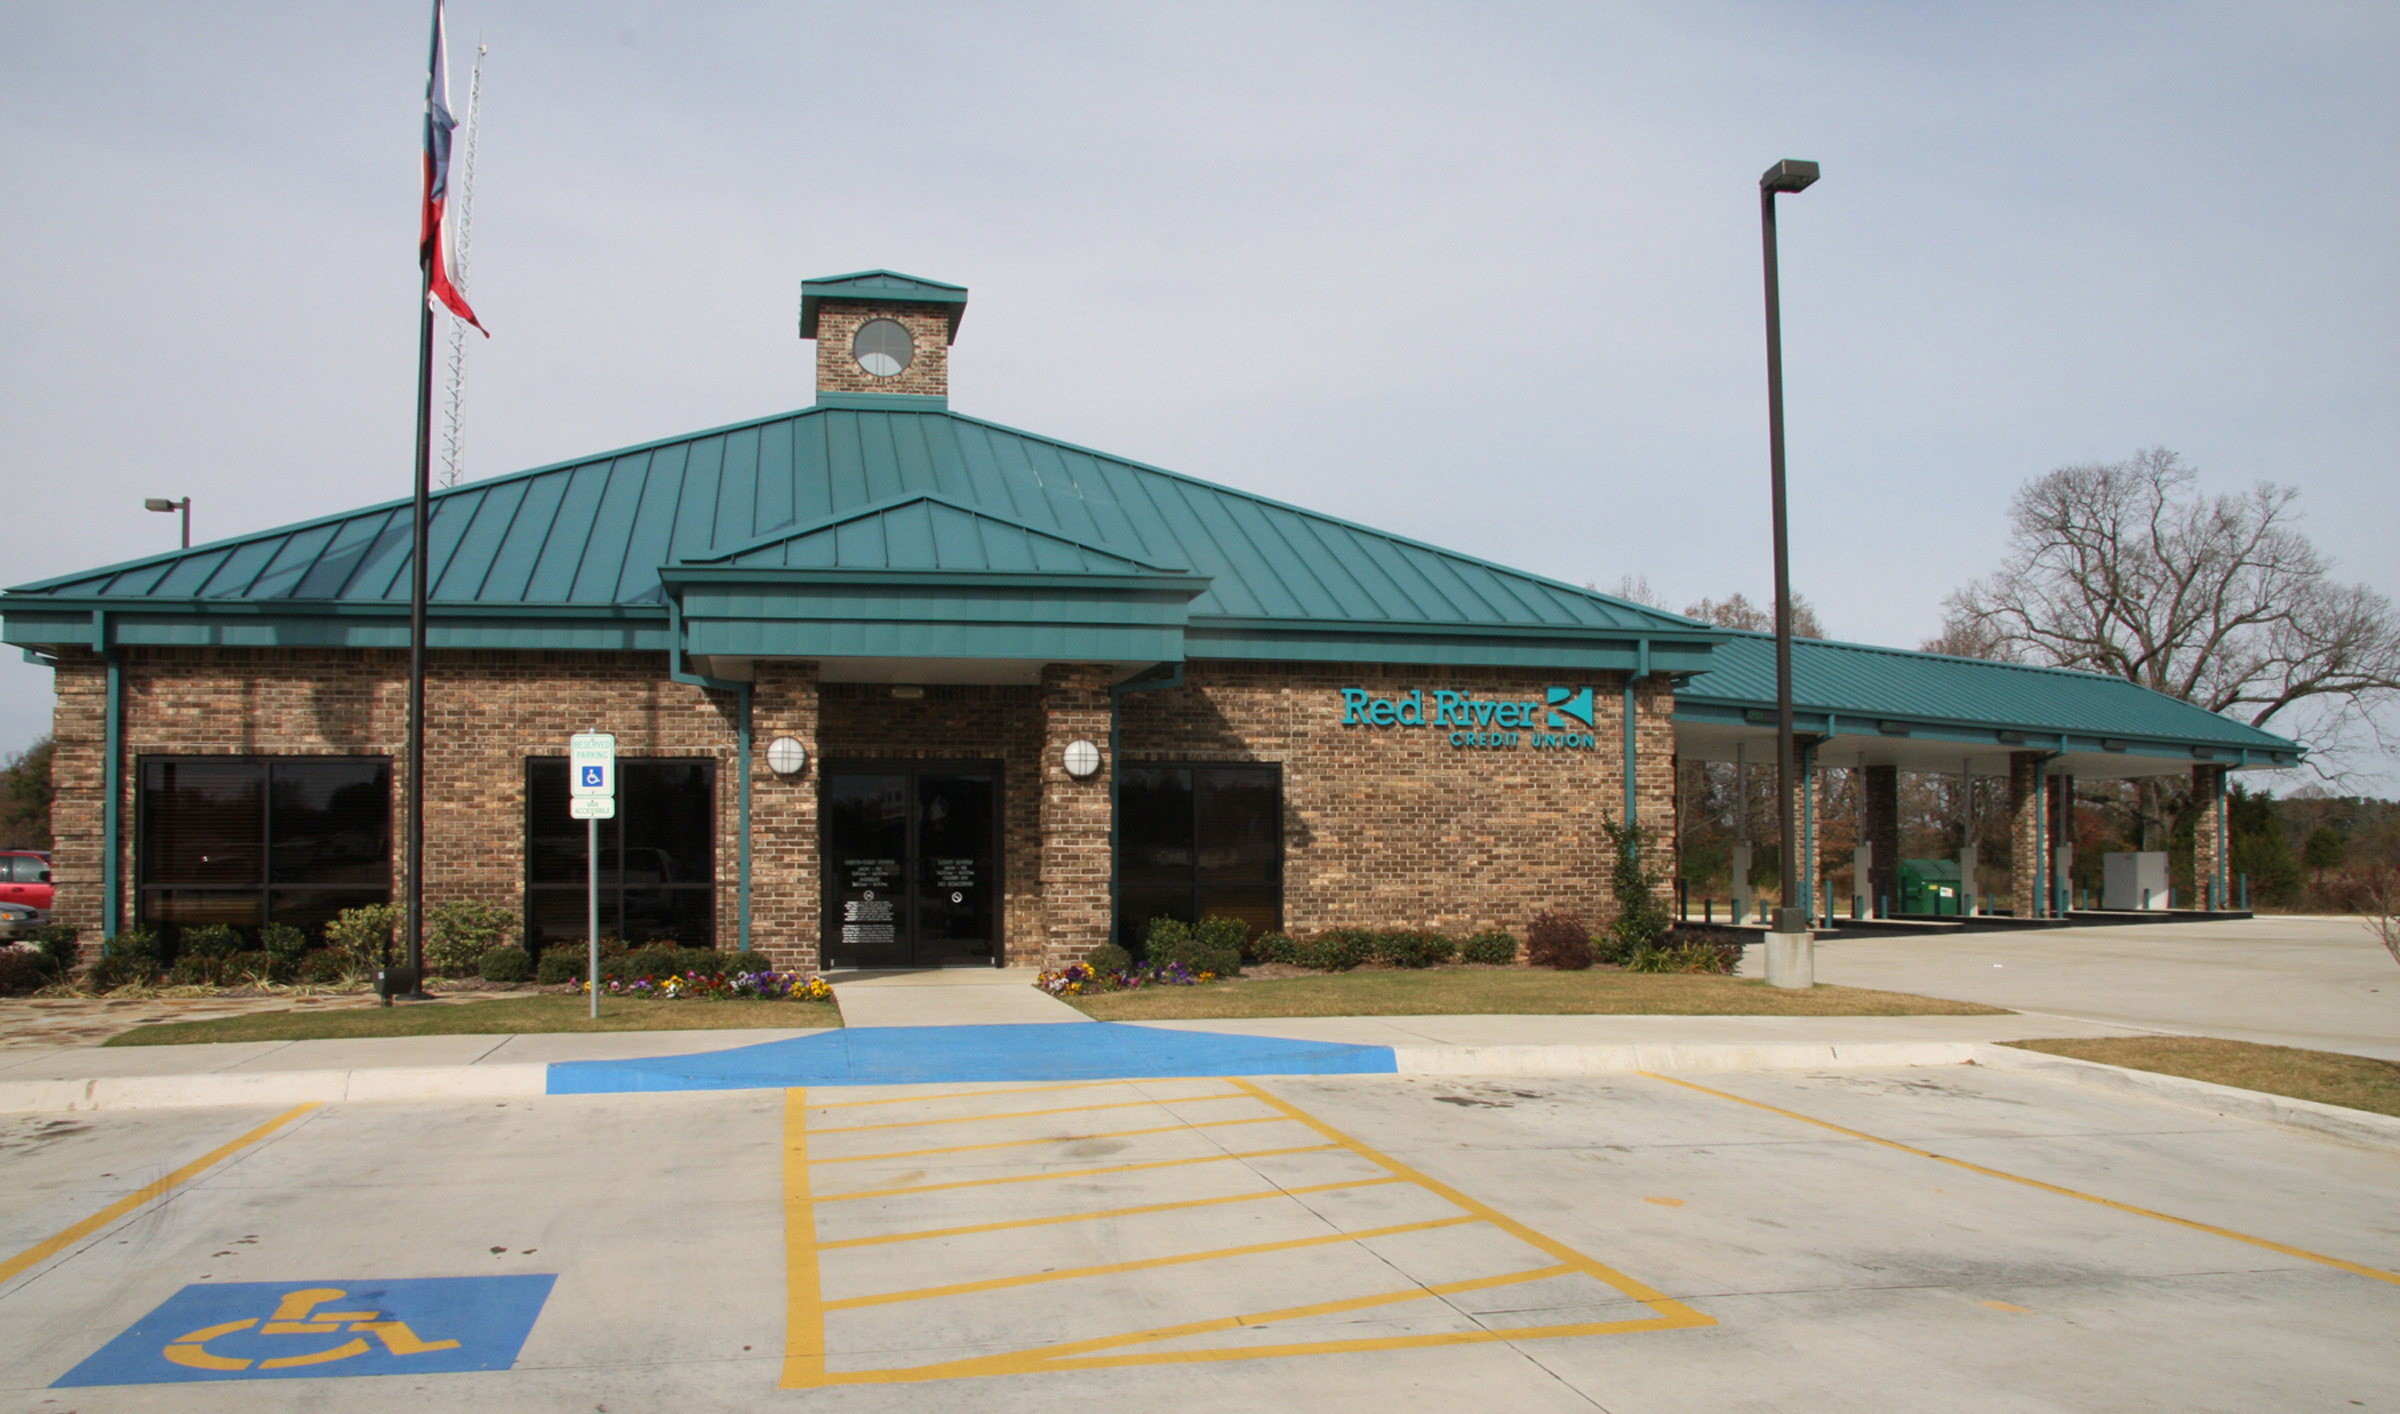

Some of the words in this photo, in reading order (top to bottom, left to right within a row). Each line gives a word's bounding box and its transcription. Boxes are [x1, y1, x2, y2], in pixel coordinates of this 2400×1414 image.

[1341, 688, 1426, 725] Red
[1433, 690, 1538, 727] River
[573, 740, 610, 749] RESERVED
[1450, 732, 1519, 747] CREDIT
[1532, 733, 1595, 748] UNION
[576, 751, 608, 759] PARKING
